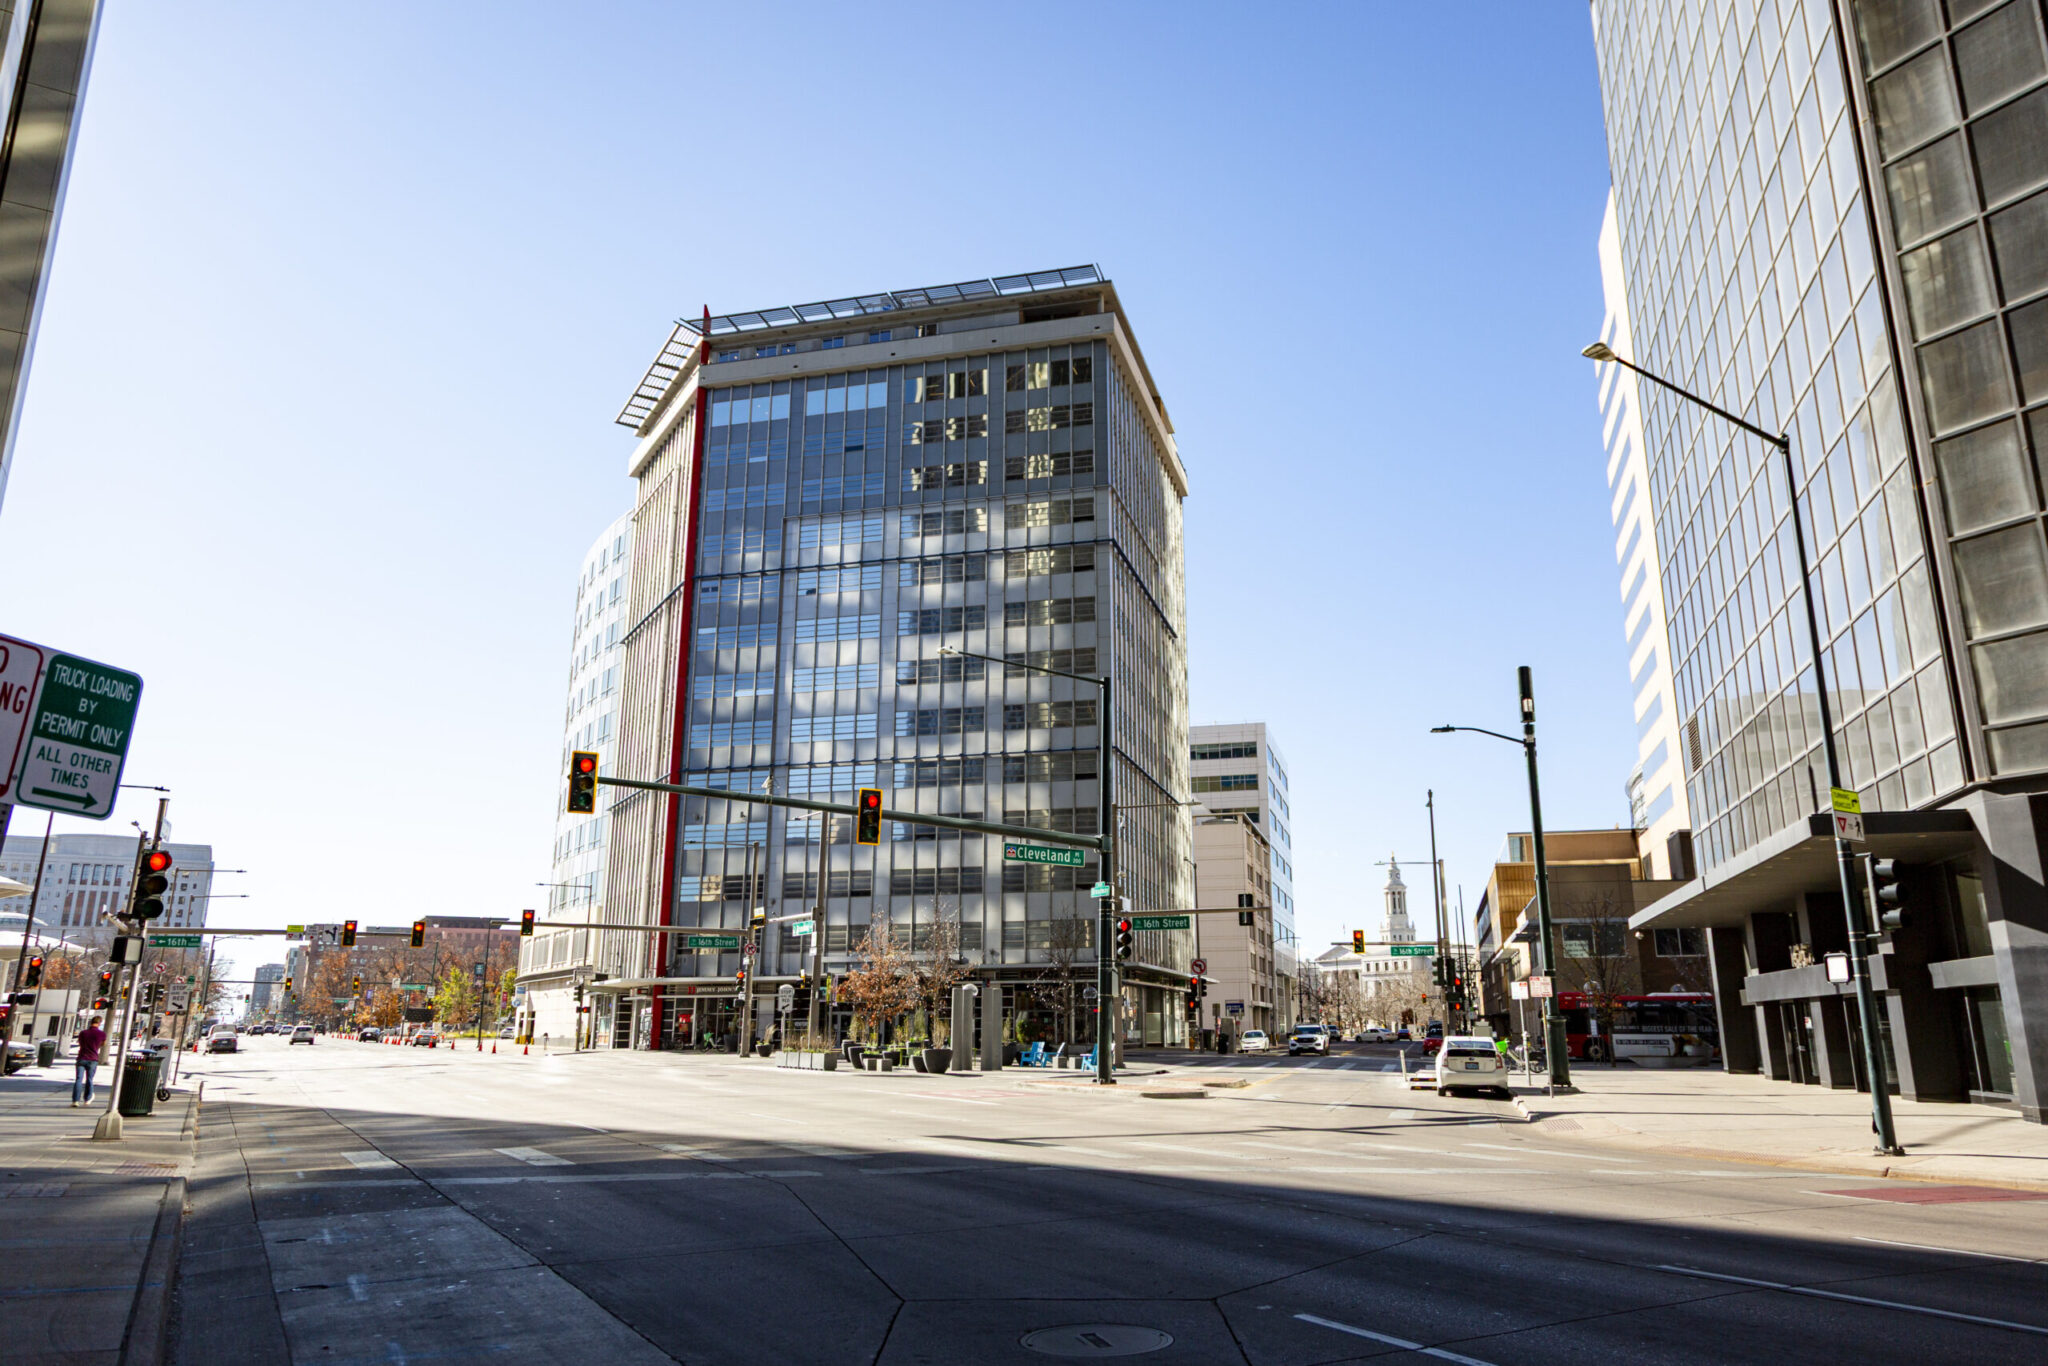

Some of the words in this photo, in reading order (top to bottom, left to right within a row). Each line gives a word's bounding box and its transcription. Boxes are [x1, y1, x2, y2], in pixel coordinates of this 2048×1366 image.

[53, 663, 89, 691] TRUCK
[89, 673, 134, 702] LOADING
[78, 697, 99, 715] BY
[39, 711, 89, 740] PERMIT
[90, 724, 124, 748] ONLY
[36, 745, 62, 764] ALL
[70, 752, 113, 775] OTHER
[50, 767, 89, 789] TIMES
[1017, 847, 1071, 863] Cleveland
[1143, 919, 1160, 928] 16th
[1162, 918, 1188, 928] Street
[167, 937, 187, 946] 16th
[698, 938, 713, 946] 16th
[714, 938, 736, 946] Street
[1413, 947, 1433, 955] Street
